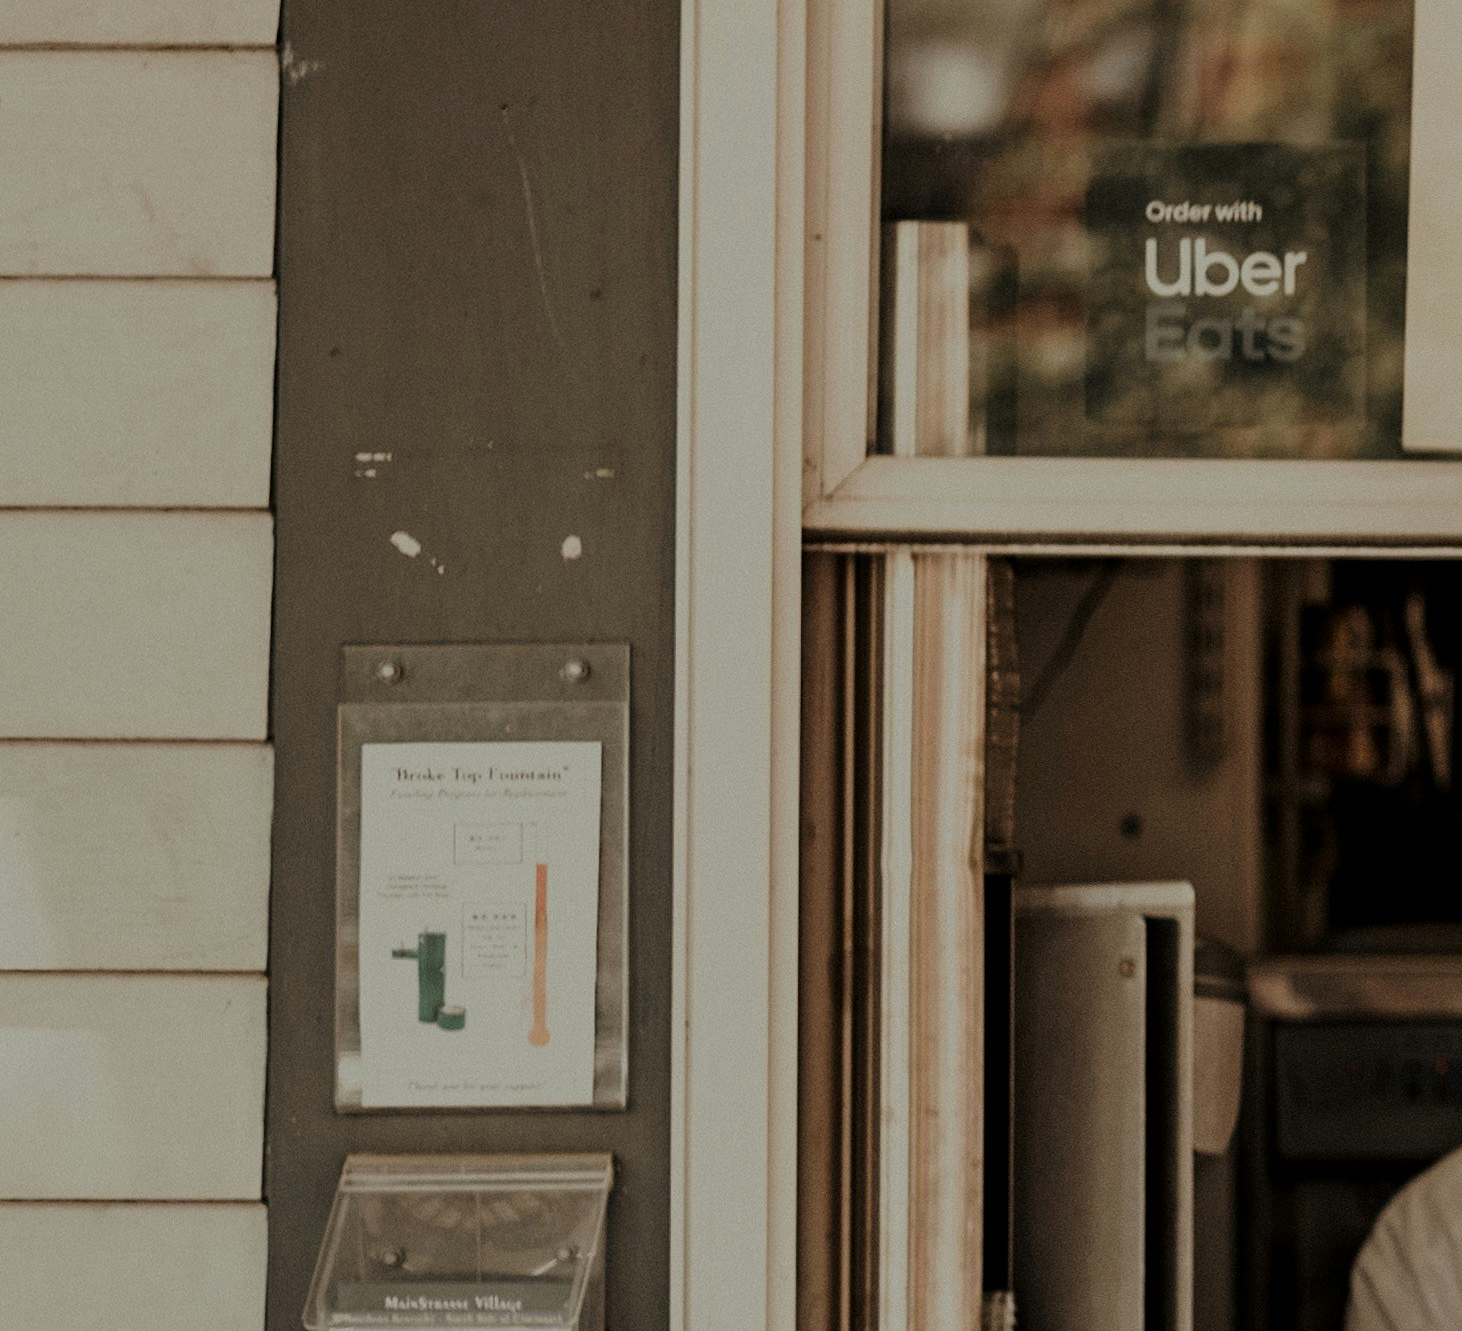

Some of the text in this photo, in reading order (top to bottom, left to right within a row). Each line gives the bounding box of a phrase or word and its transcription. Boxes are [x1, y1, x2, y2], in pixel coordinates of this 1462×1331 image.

[1146, 200, 1263, 222] Order with
[1145, 237, 1307, 297] Uber
[1145, 302, 1305, 361] Eats
[475, 1295, 522, 1313] Village
